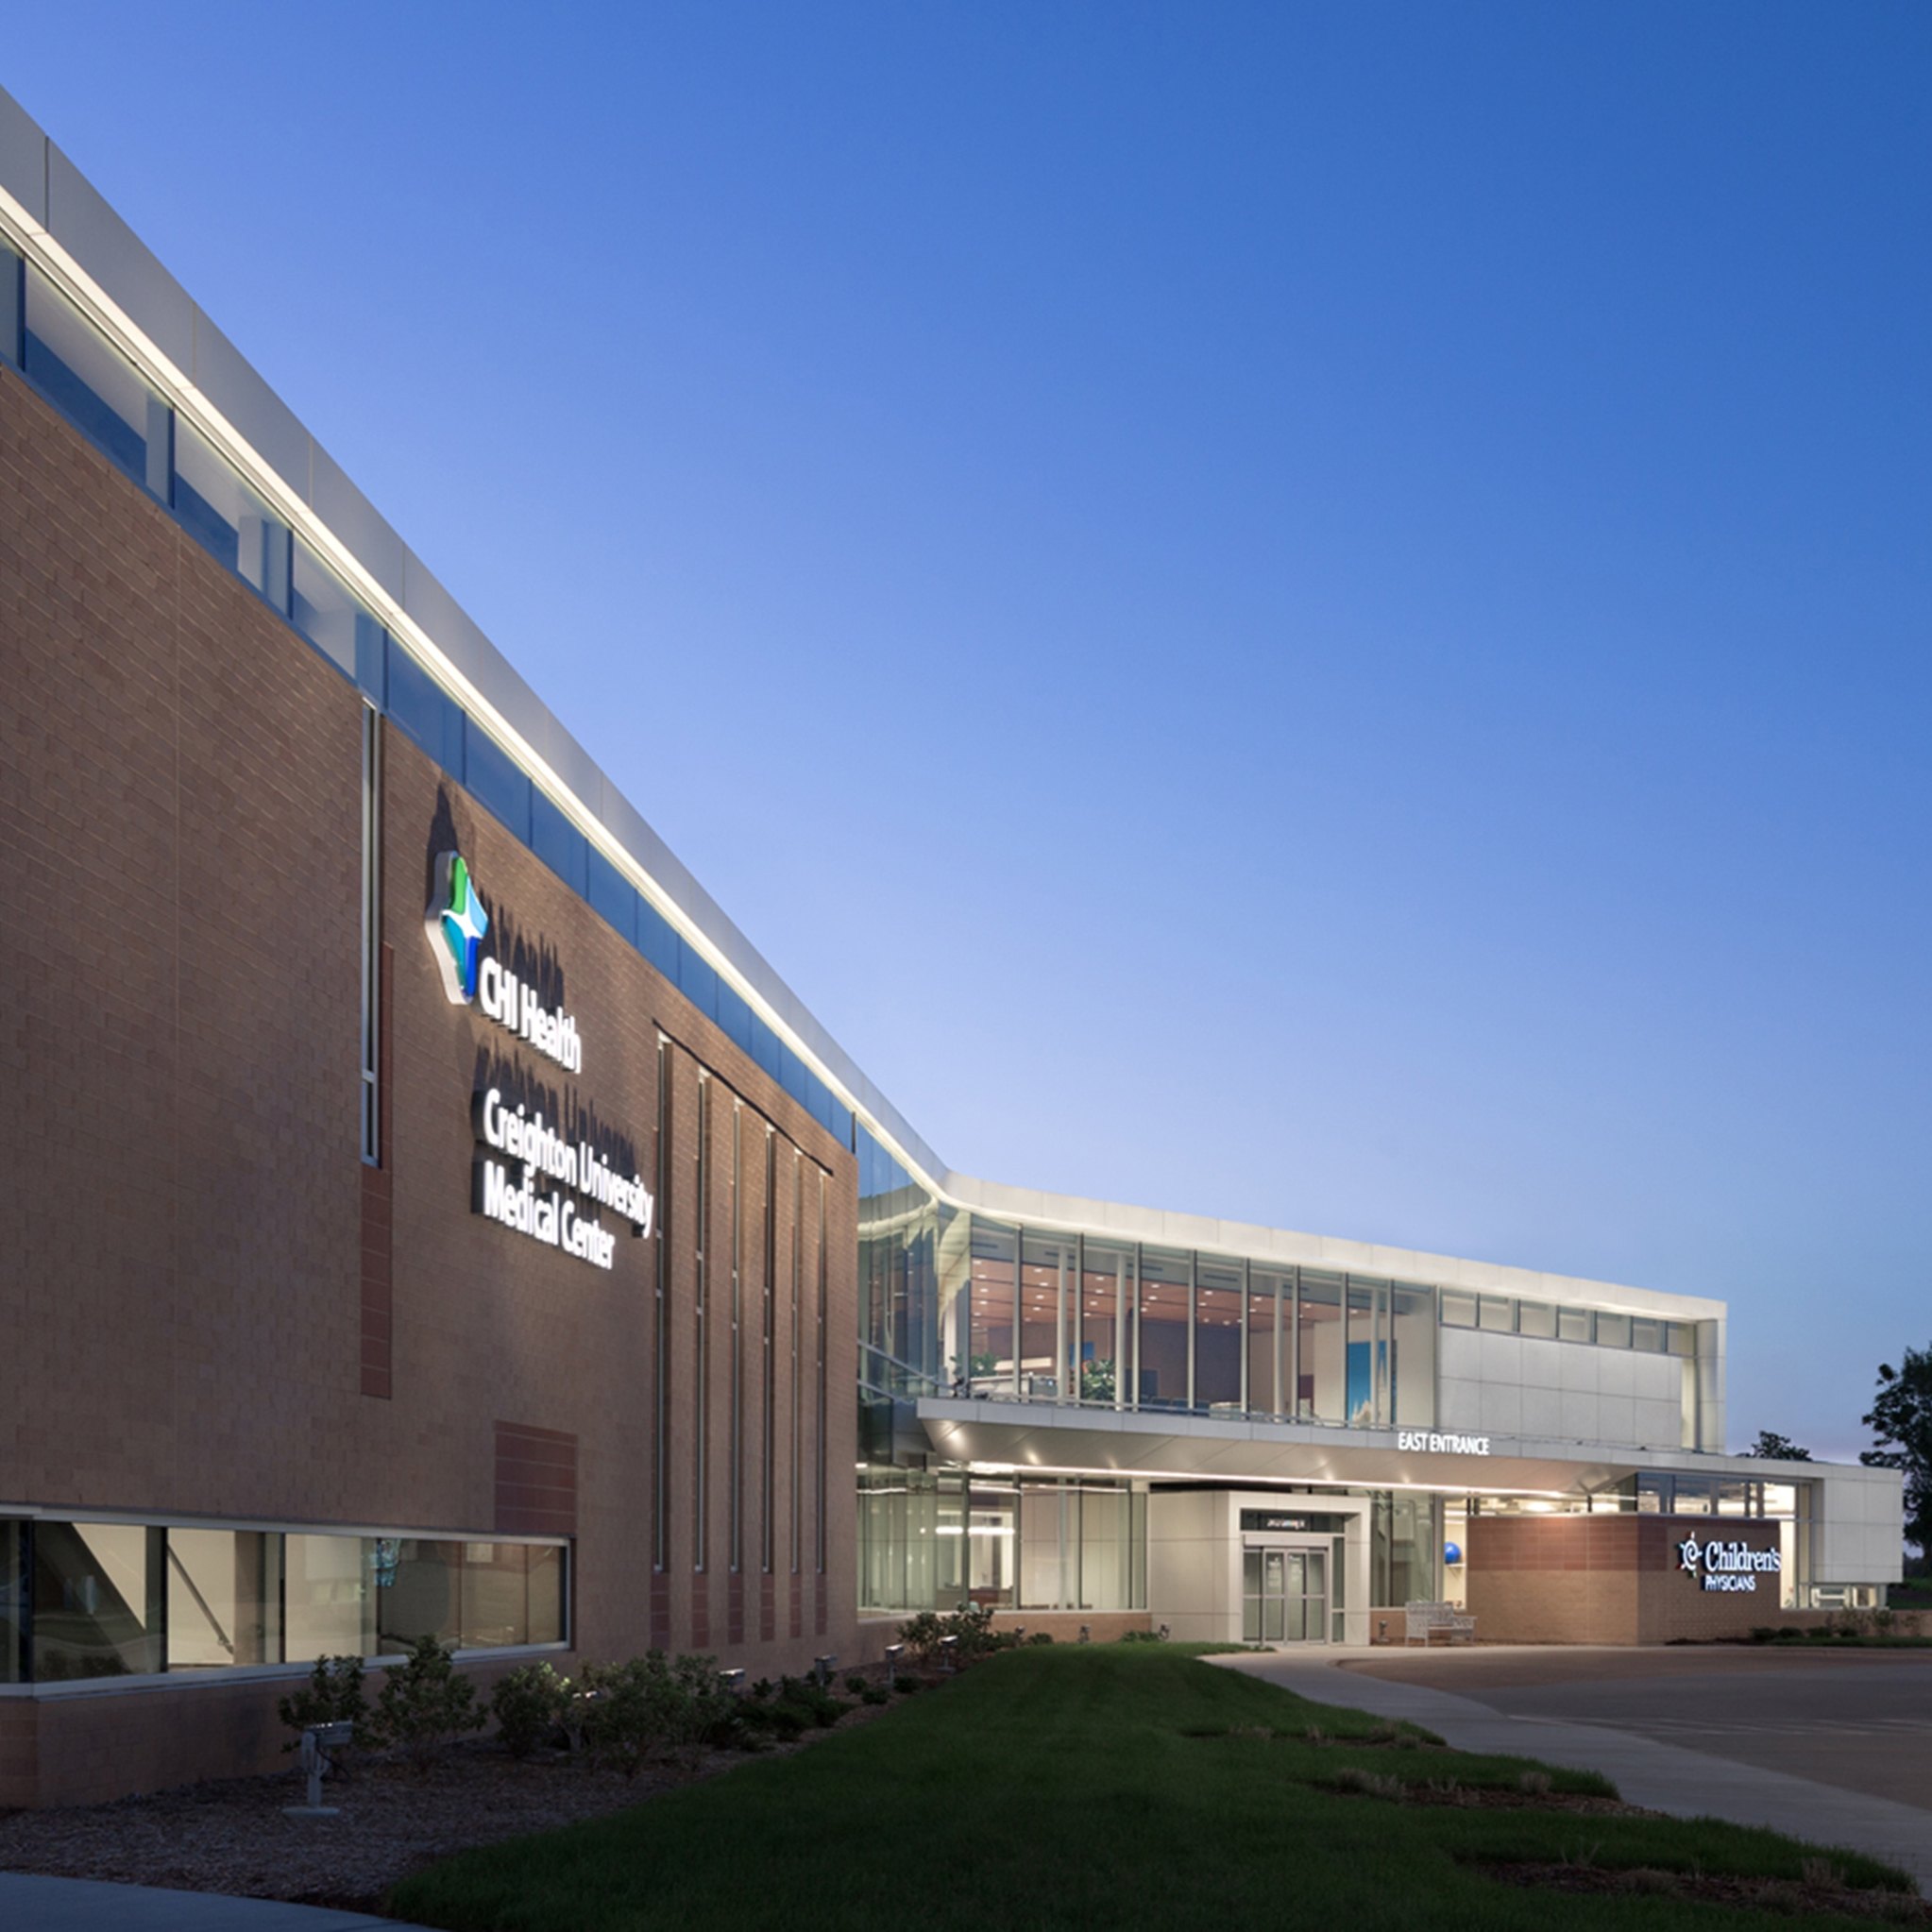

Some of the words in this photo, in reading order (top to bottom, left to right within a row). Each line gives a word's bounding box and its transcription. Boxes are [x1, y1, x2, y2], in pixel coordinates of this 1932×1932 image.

[479, 956, 518, 1030] CHI
[520, 983, 582, 1074] Health
[483, 1088, 578, 1187] Creighton
[579, 1141, 653, 1239] University
[483, 1160, 559, 1246] Medical
[561, 1199, 615, 1270] Center
[1398, 1432, 1428, 1451] EAST
[1429, 1433, 1490, 1455] ENTRANCE
[1703, 1574, 1756, 1592] PHYSICIANS
[1704, 1541, 1782, 1572] Children's
